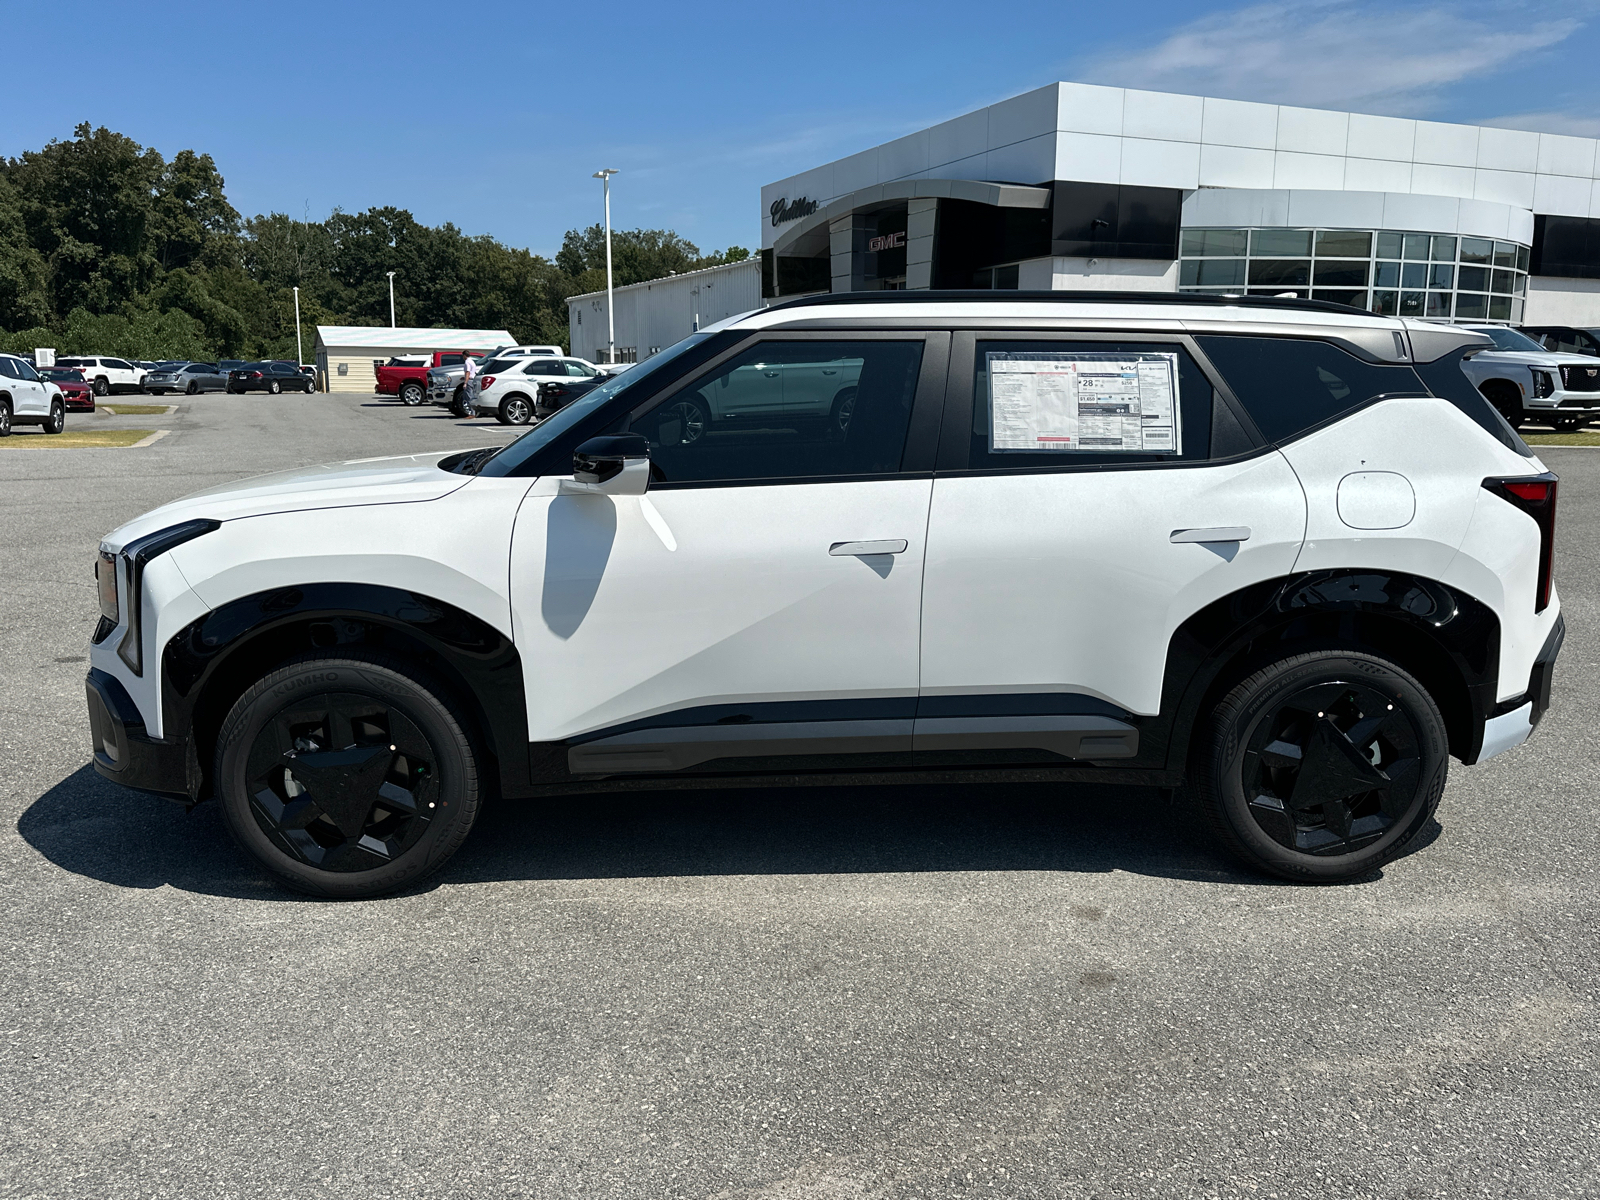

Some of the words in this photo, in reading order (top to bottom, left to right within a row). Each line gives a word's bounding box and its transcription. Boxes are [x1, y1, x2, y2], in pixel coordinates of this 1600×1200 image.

[770, 196, 817, 227] Cadillac
[869, 231, 906, 252] GMC
[1082, 379, 1094, 387] 28
[271, 672, 339, 698] KUMHO
[1248, 683, 1280, 715] PREMIUM
[1281, 664, 1331, 687] ALL-SEASON
[1400, 685, 1437, 735] SOLUS
[356, 862, 417, 891] SOLUS
